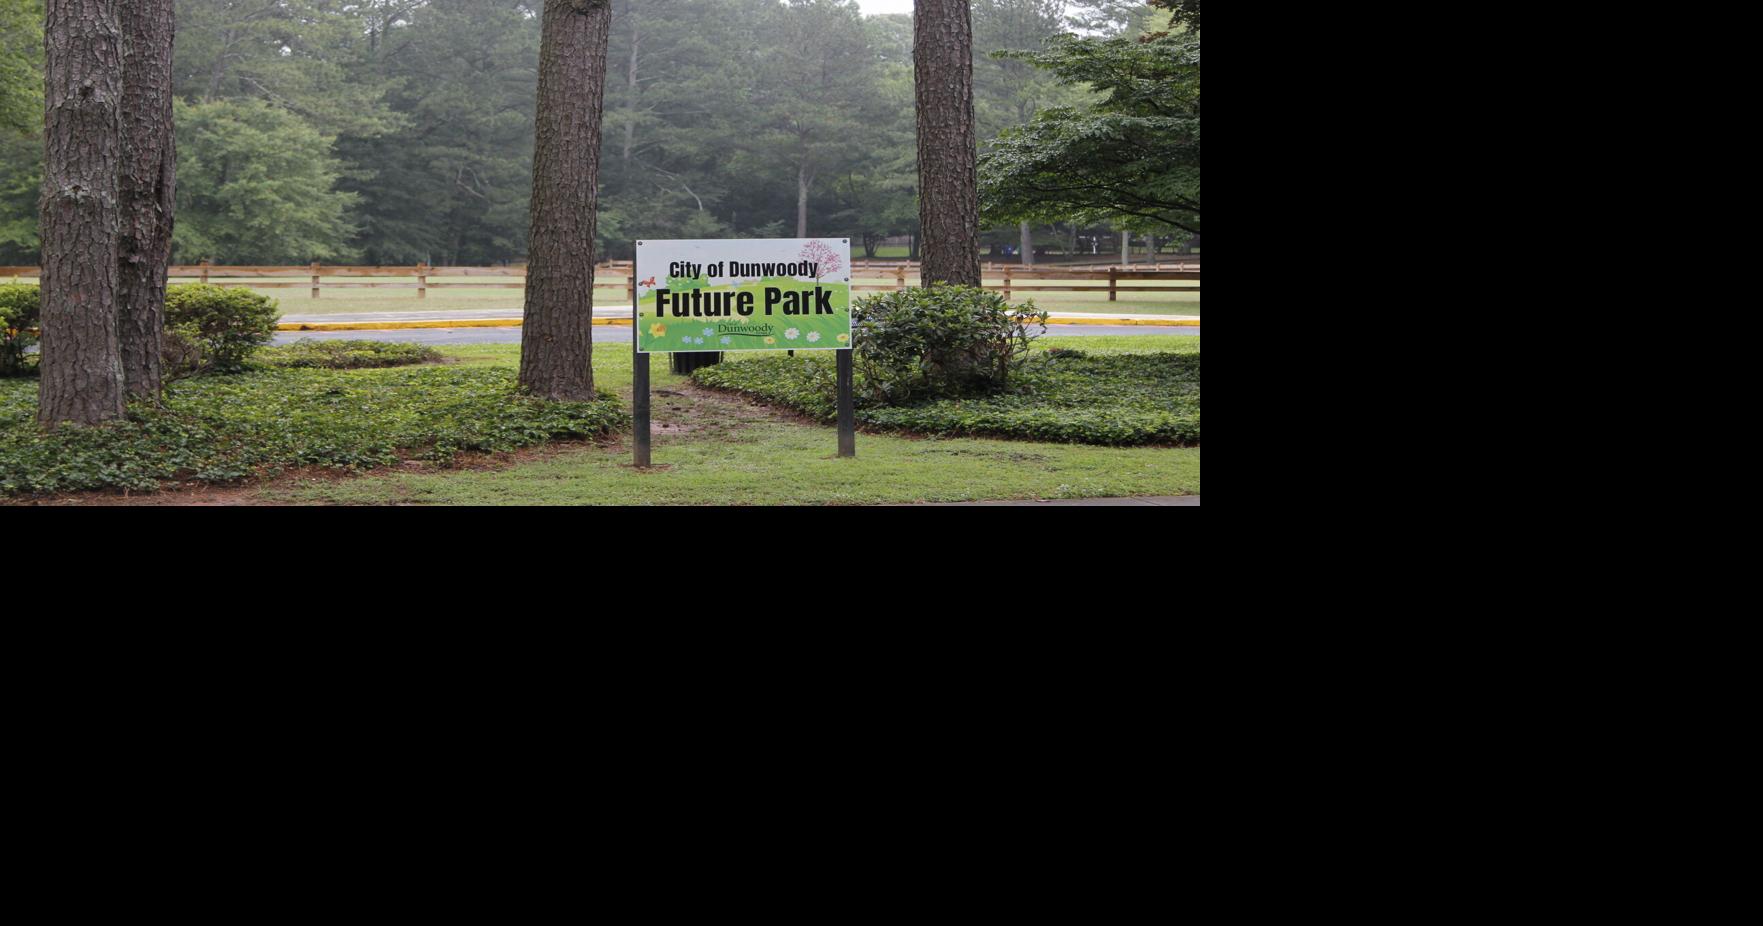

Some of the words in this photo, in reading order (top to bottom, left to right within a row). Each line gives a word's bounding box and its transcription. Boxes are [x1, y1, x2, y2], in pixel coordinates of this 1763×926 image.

[669, 261, 702, 280] City
[707, 261, 725, 277] of
[729, 260, 818, 279] Dunwoody
[656, 288, 754, 317] Future
[764, 286, 834, 316] Park
[718, 323, 774, 335] Dunwoody
